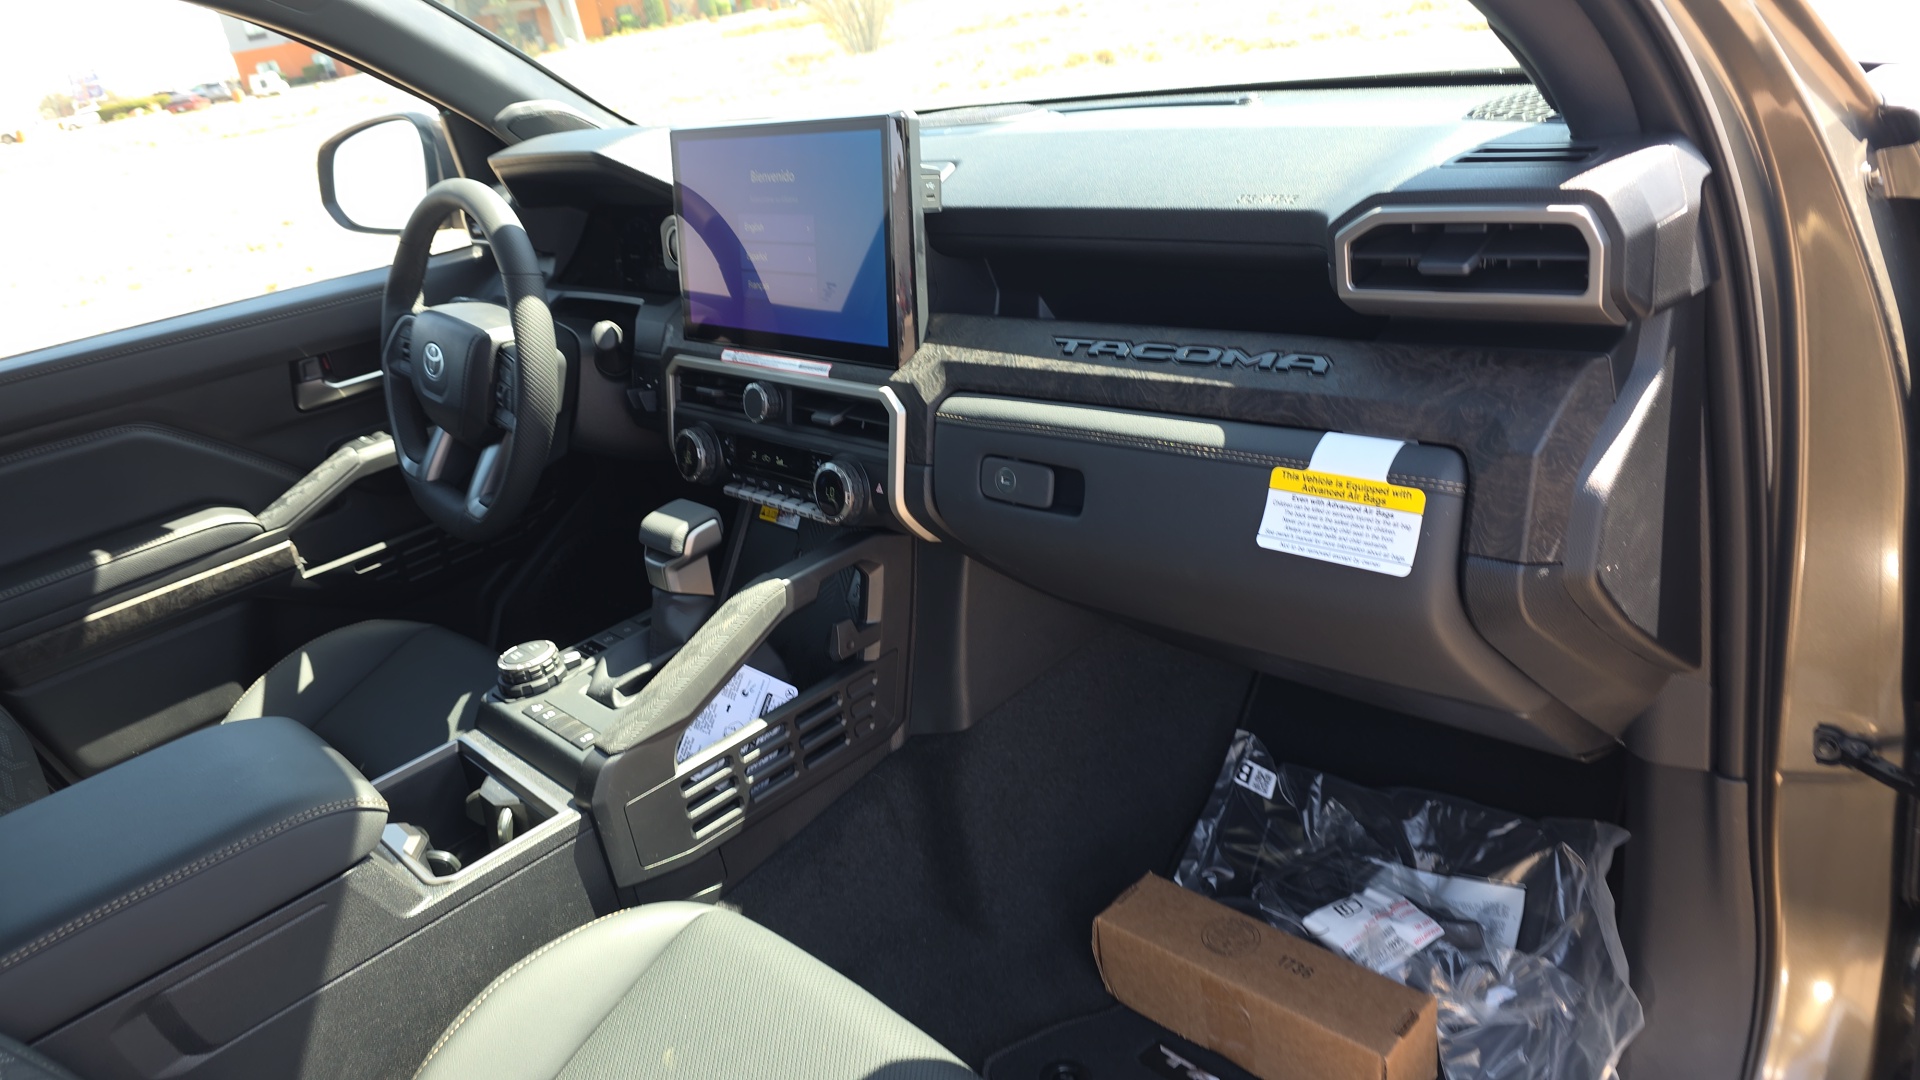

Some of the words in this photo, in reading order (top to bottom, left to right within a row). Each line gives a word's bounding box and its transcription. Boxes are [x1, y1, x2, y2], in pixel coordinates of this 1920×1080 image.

[750, 169, 796, 184] Bienvenido
[1054, 336, 1334, 376] TACOMA
[1282, 471, 1298, 479] This
[1303, 474, 1332, 485] Vehicle
[1347, 481, 1388, 496] Equipped
[1393, 489, 1412, 498] with
[1303, 485, 1344, 496] Advanced
[1365, 495, 1386, 506] Bags
